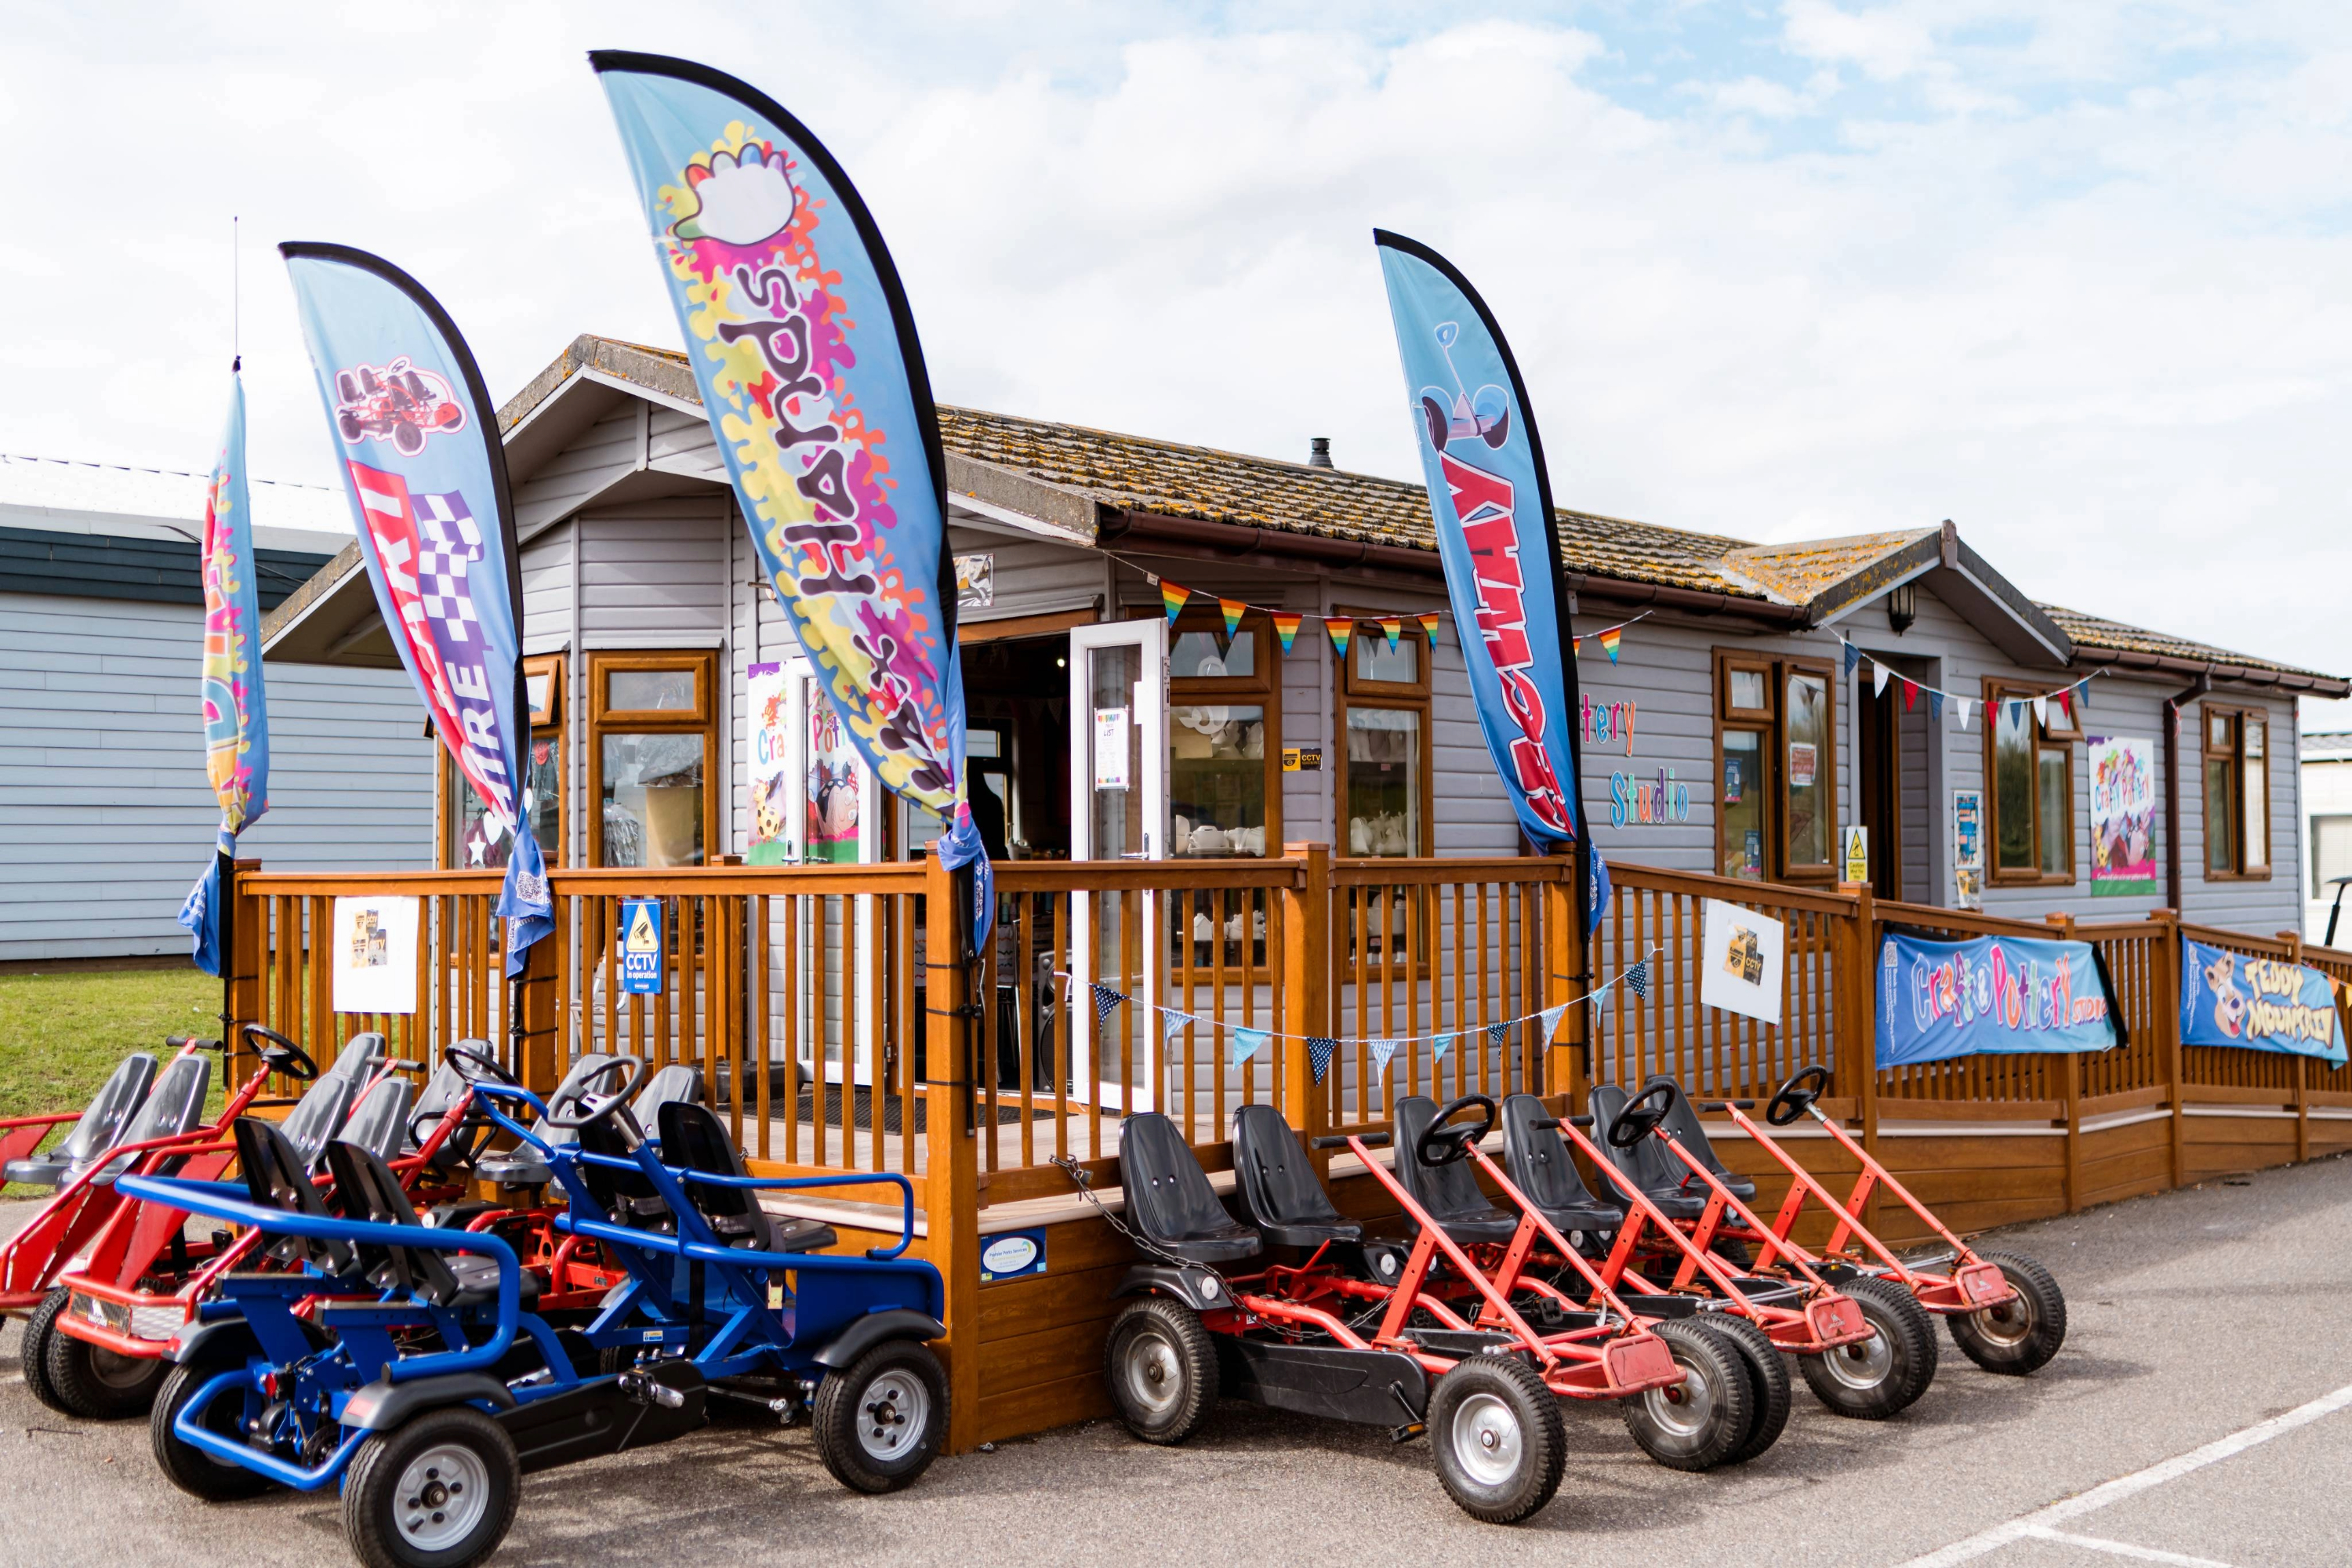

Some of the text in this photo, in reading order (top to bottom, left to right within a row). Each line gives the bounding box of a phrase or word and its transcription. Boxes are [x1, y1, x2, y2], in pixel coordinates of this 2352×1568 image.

[1581, 693, 1637, 757] tery
[758, 728, 786, 765] Cra
[1610, 766, 1690, 830] Studio
[2095, 774, 2150, 815] Crafty Pottery
[626, 953, 658, 971] CCTV
[633, 971, 658, 981] operation
[1745, 957, 1762, 971] CCTV
[2244, 958, 2304, 1007] TEDDY
[1990, 943, 2072, 1031] Pottery
